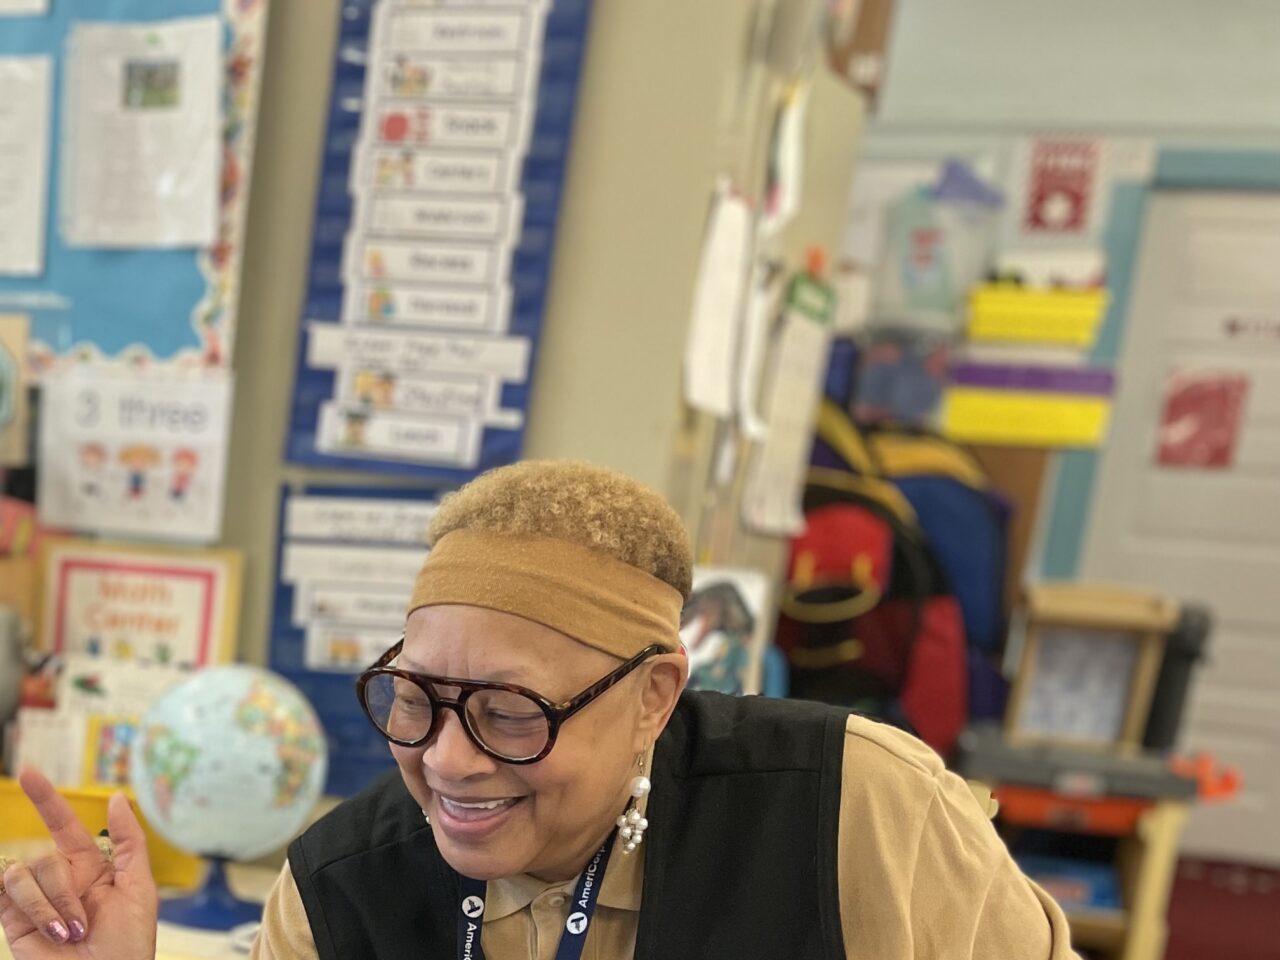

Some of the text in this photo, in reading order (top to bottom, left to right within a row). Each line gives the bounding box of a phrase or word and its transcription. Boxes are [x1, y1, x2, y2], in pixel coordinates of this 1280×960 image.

[77, 389, 208, 433] 3 three
[99, 576, 170, 601] Math
[84, 604, 179, 636] Center
